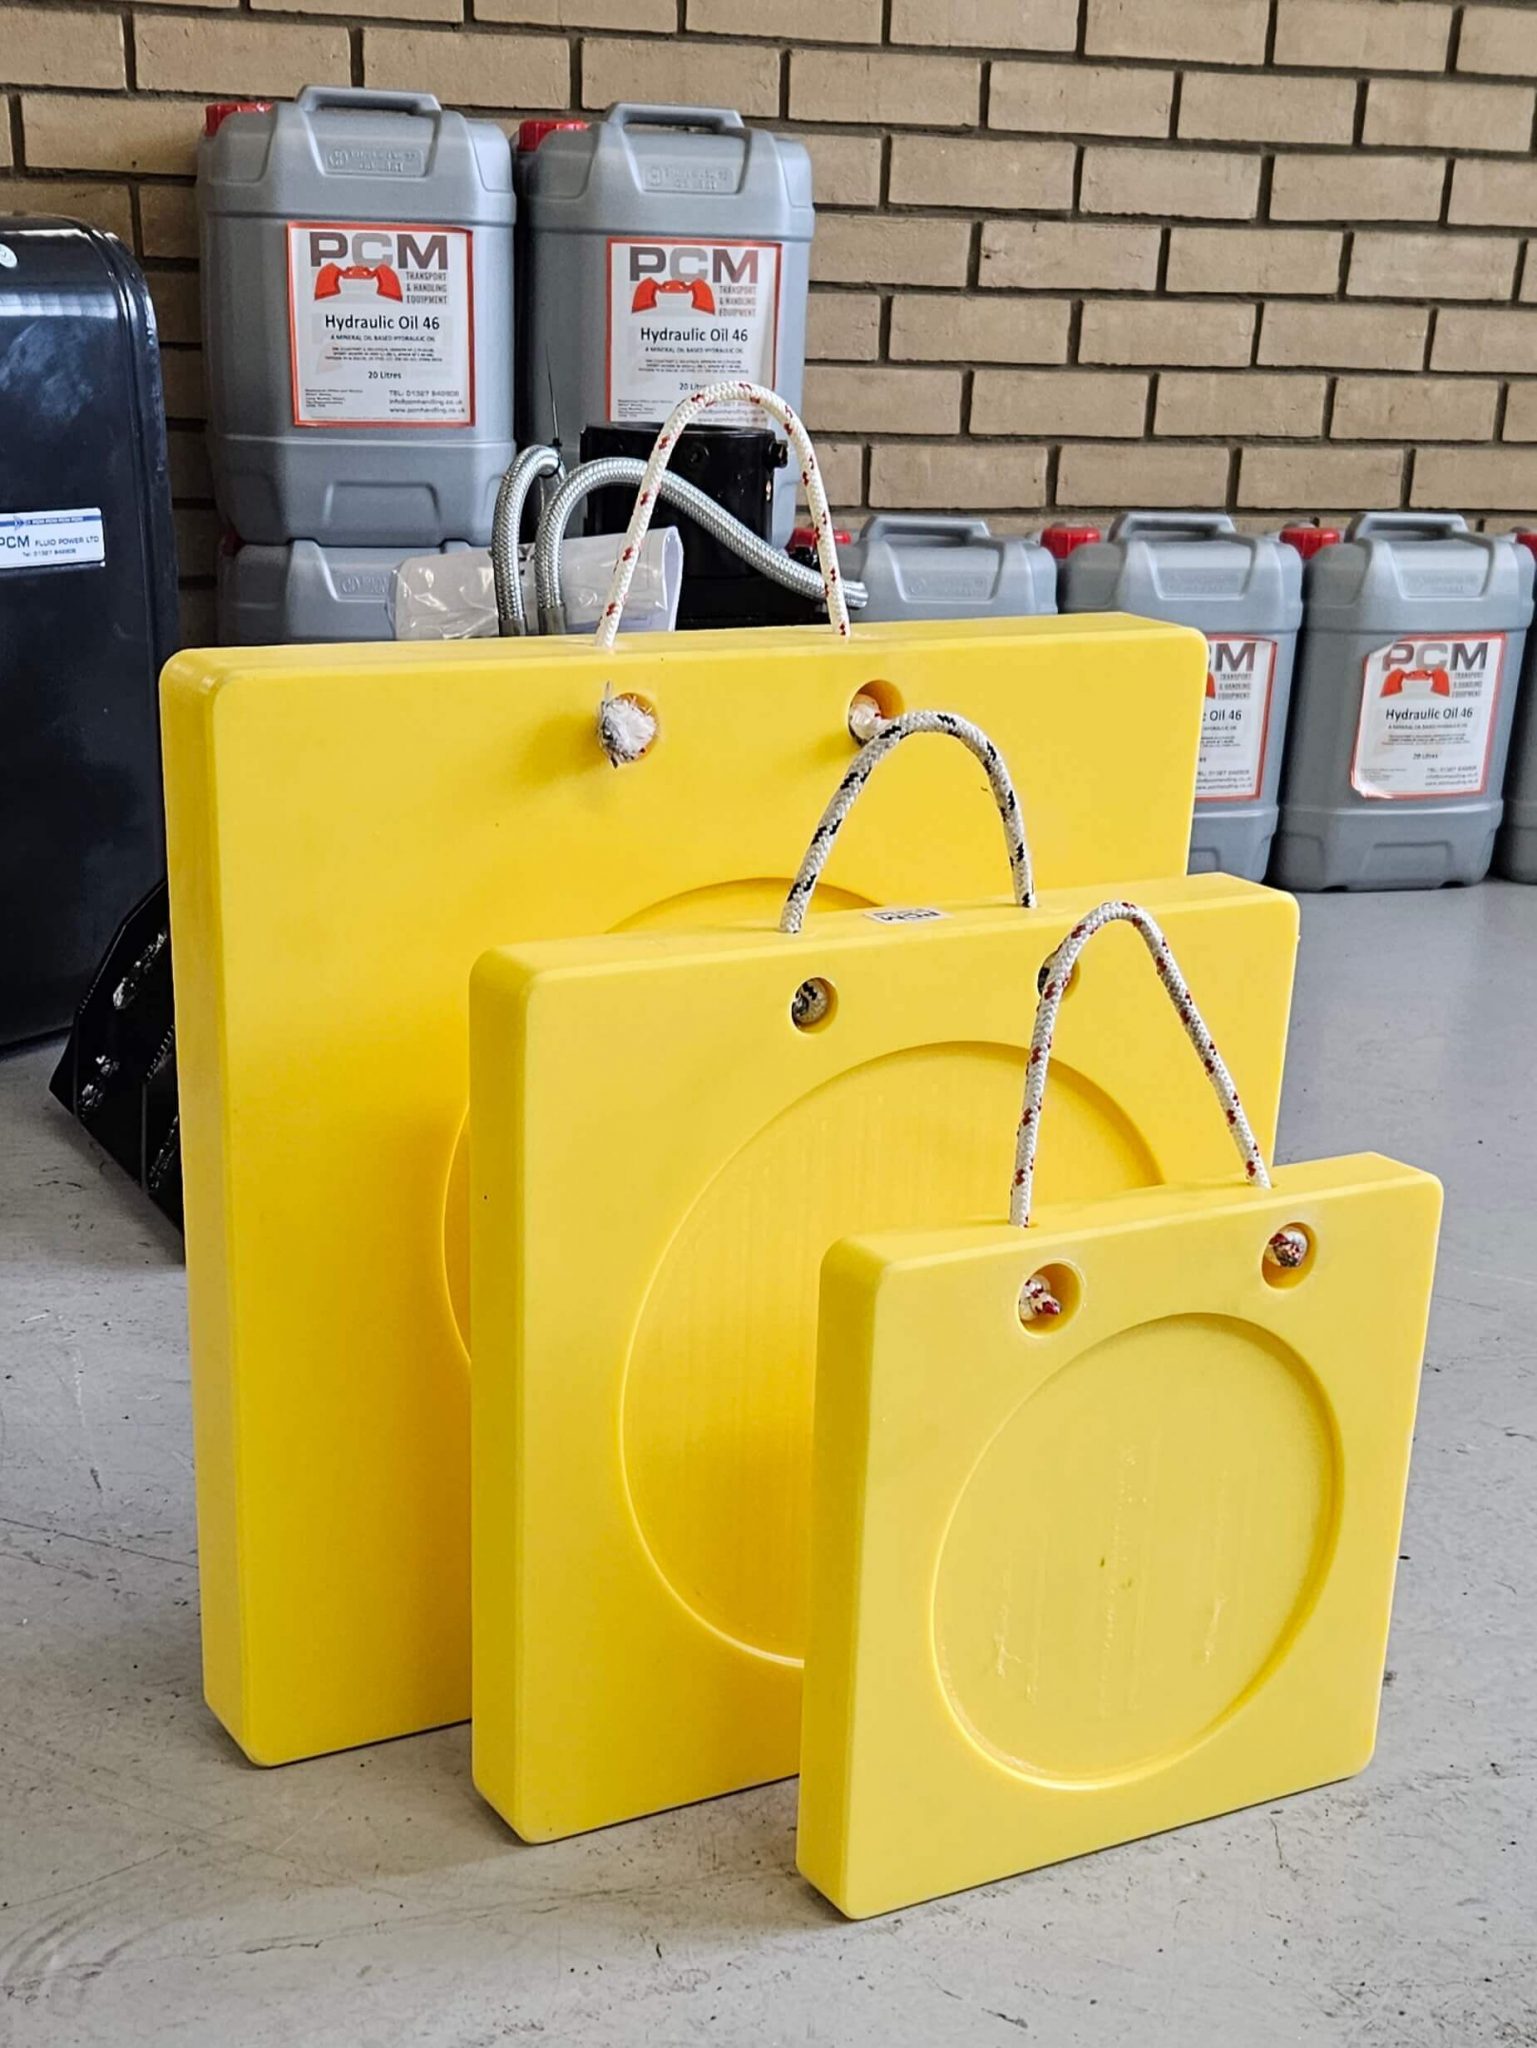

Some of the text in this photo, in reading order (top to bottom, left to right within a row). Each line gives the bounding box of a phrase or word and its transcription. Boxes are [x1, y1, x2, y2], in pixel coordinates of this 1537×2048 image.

[309, 232, 448, 270] PCM
[630, 246, 758, 284] PCM
[406, 271, 447, 281] TRANSPORT
[406, 283, 447, 293] & HANDLING
[719, 286, 756, 294] TRANSPORT
[406, 295, 447, 304] EQUIPMENT
[725, 297, 756, 305] HANDLING
[719, 308, 756, 317] EQUIPMENT
[325, 315, 440, 331] Hydraulic Oil 46
[640, 327, 748, 344] Hydraulic Oil 46
[367, 371, 402, 380] 20 Litres
[679, 383, 689, 391] 20
[35, 538, 57, 547] FLUID
[58, 536, 84, 545] POWER
[86, 535, 100, 544] LTD
[1382, 642, 1489, 672] PCM
[1209, 709, 1225, 721] Oil
[1229, 709, 1242, 721] 46
[1385, 706, 1474, 722] Hydraulic Oil 46
